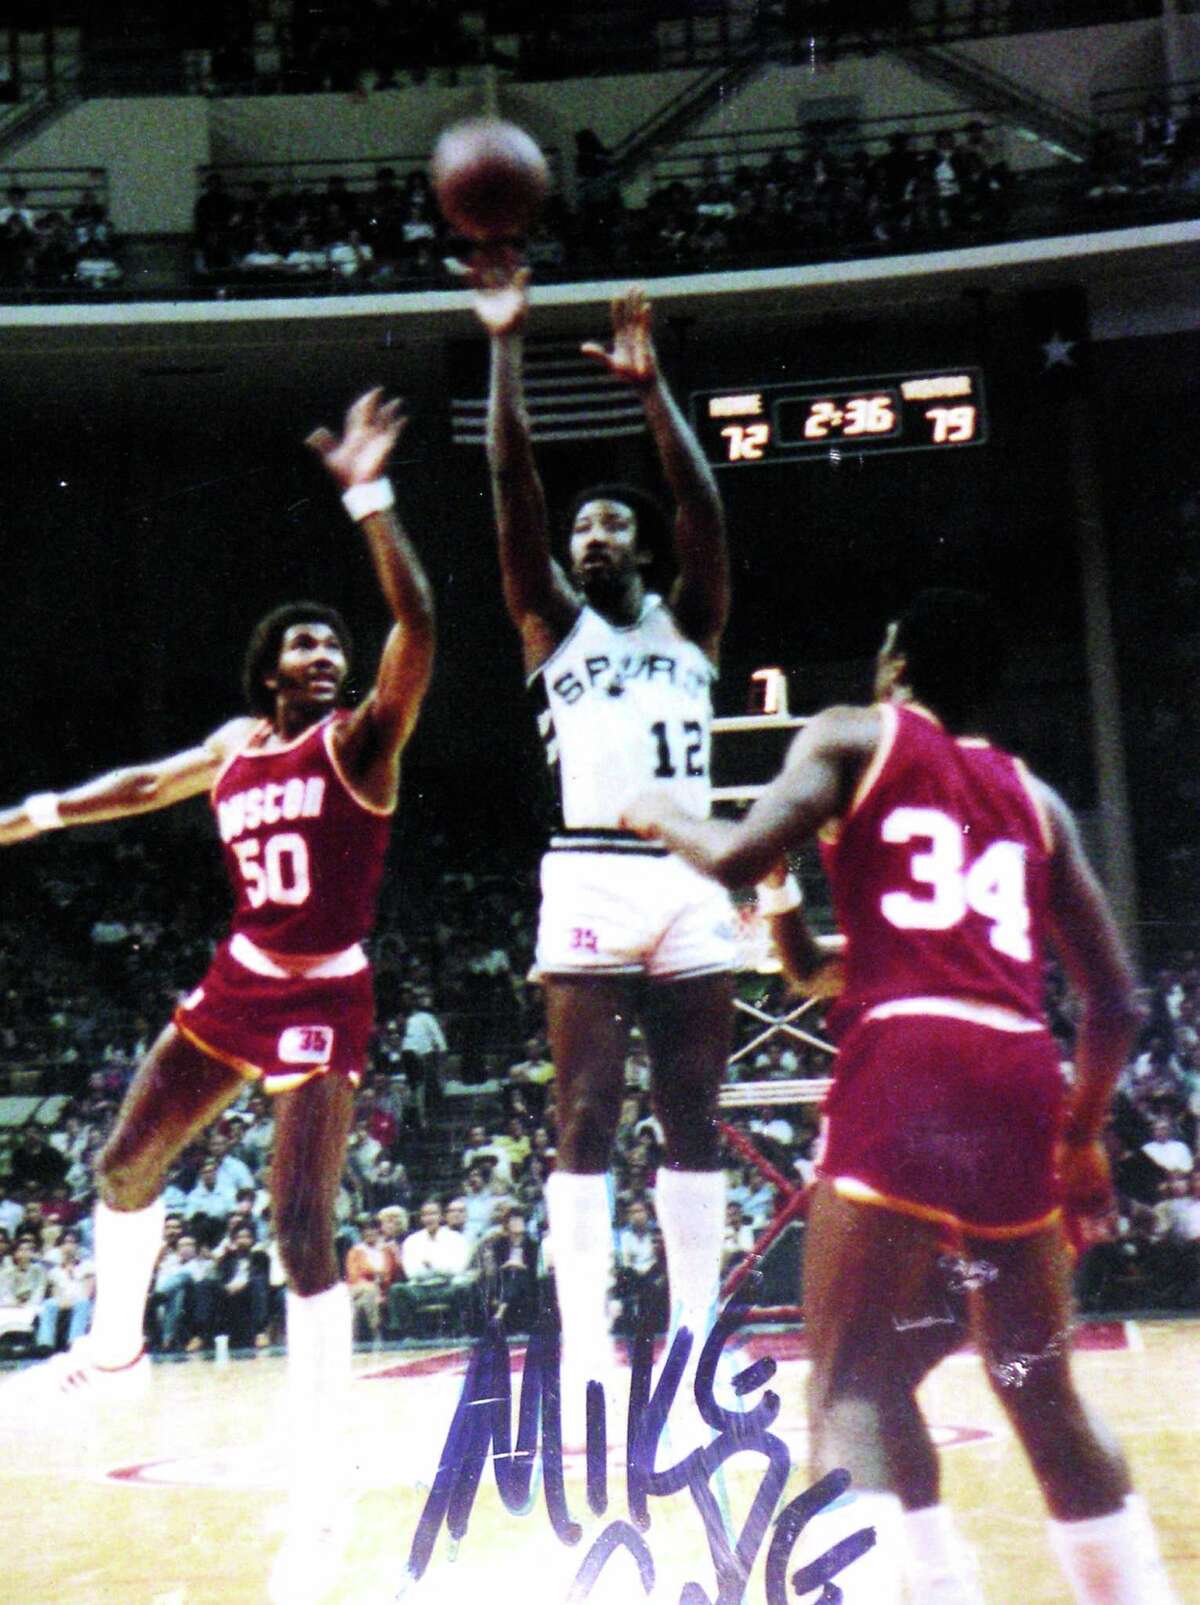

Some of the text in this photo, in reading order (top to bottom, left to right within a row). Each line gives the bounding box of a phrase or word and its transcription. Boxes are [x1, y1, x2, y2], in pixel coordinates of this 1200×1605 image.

[651, 720, 704, 778] 12
[231, 832, 312, 909] 50
[880, 806, 1033, 963] 34
